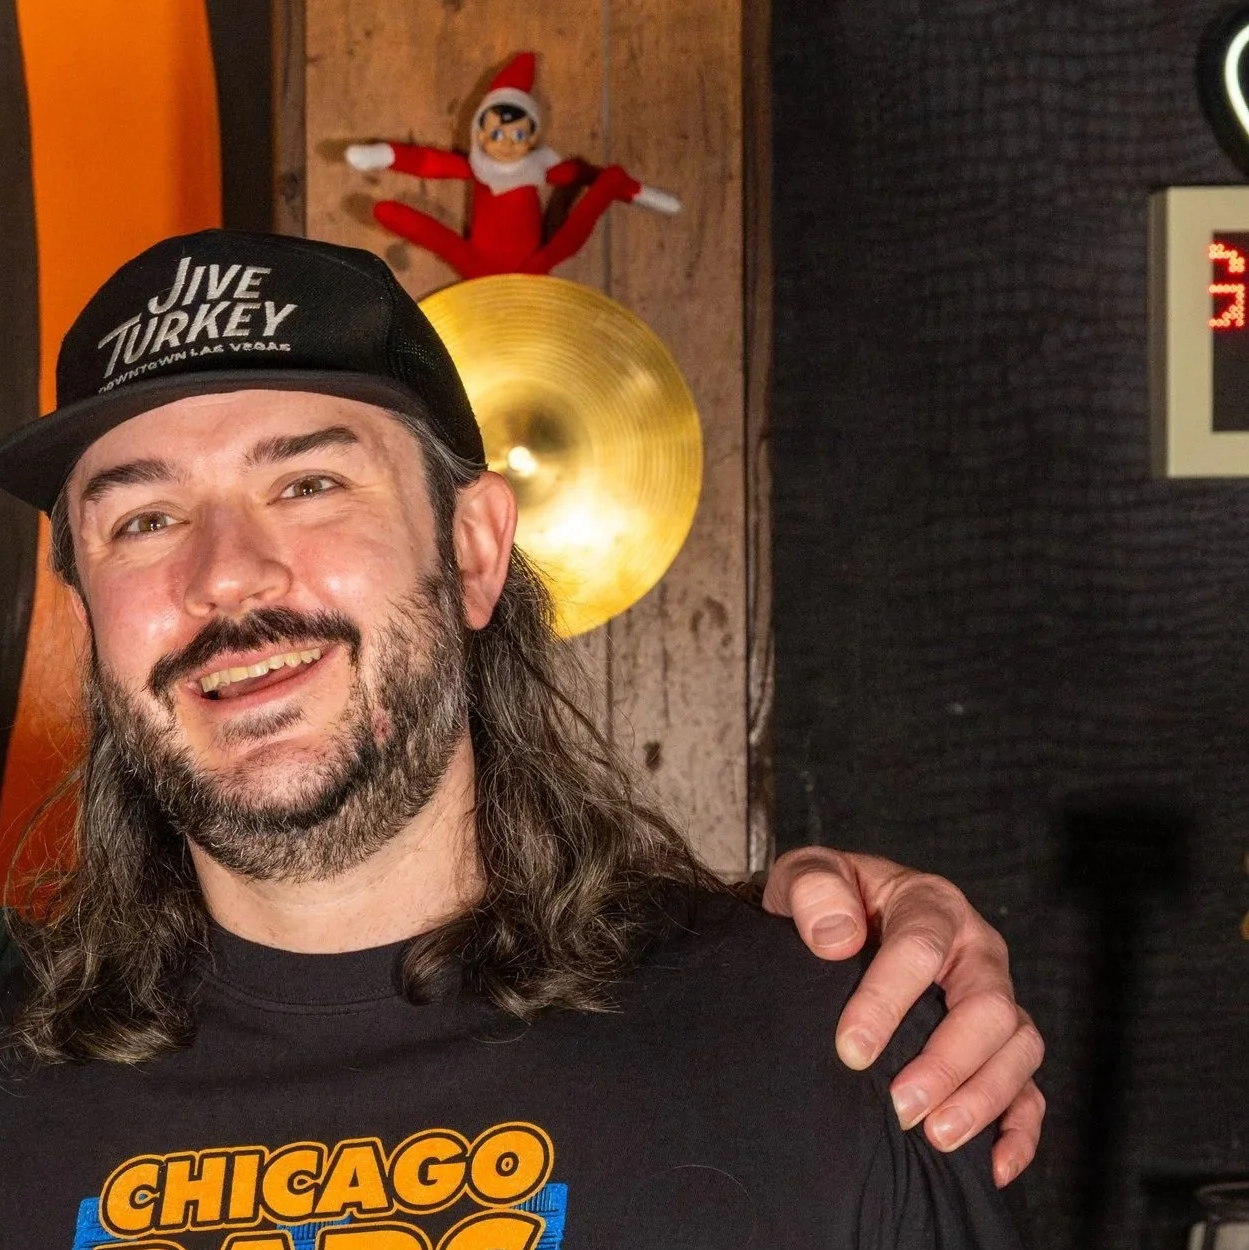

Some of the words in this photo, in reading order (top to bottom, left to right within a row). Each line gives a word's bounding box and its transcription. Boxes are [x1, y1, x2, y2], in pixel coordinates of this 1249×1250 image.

[148, 257, 271, 314] JIVE
[97, 301, 298, 378] TURKEY
[190, 344, 225, 357] LAS
[229, 341, 291, 352] VEGAS
[99, 1122, 554, 1238] CHICAGO
